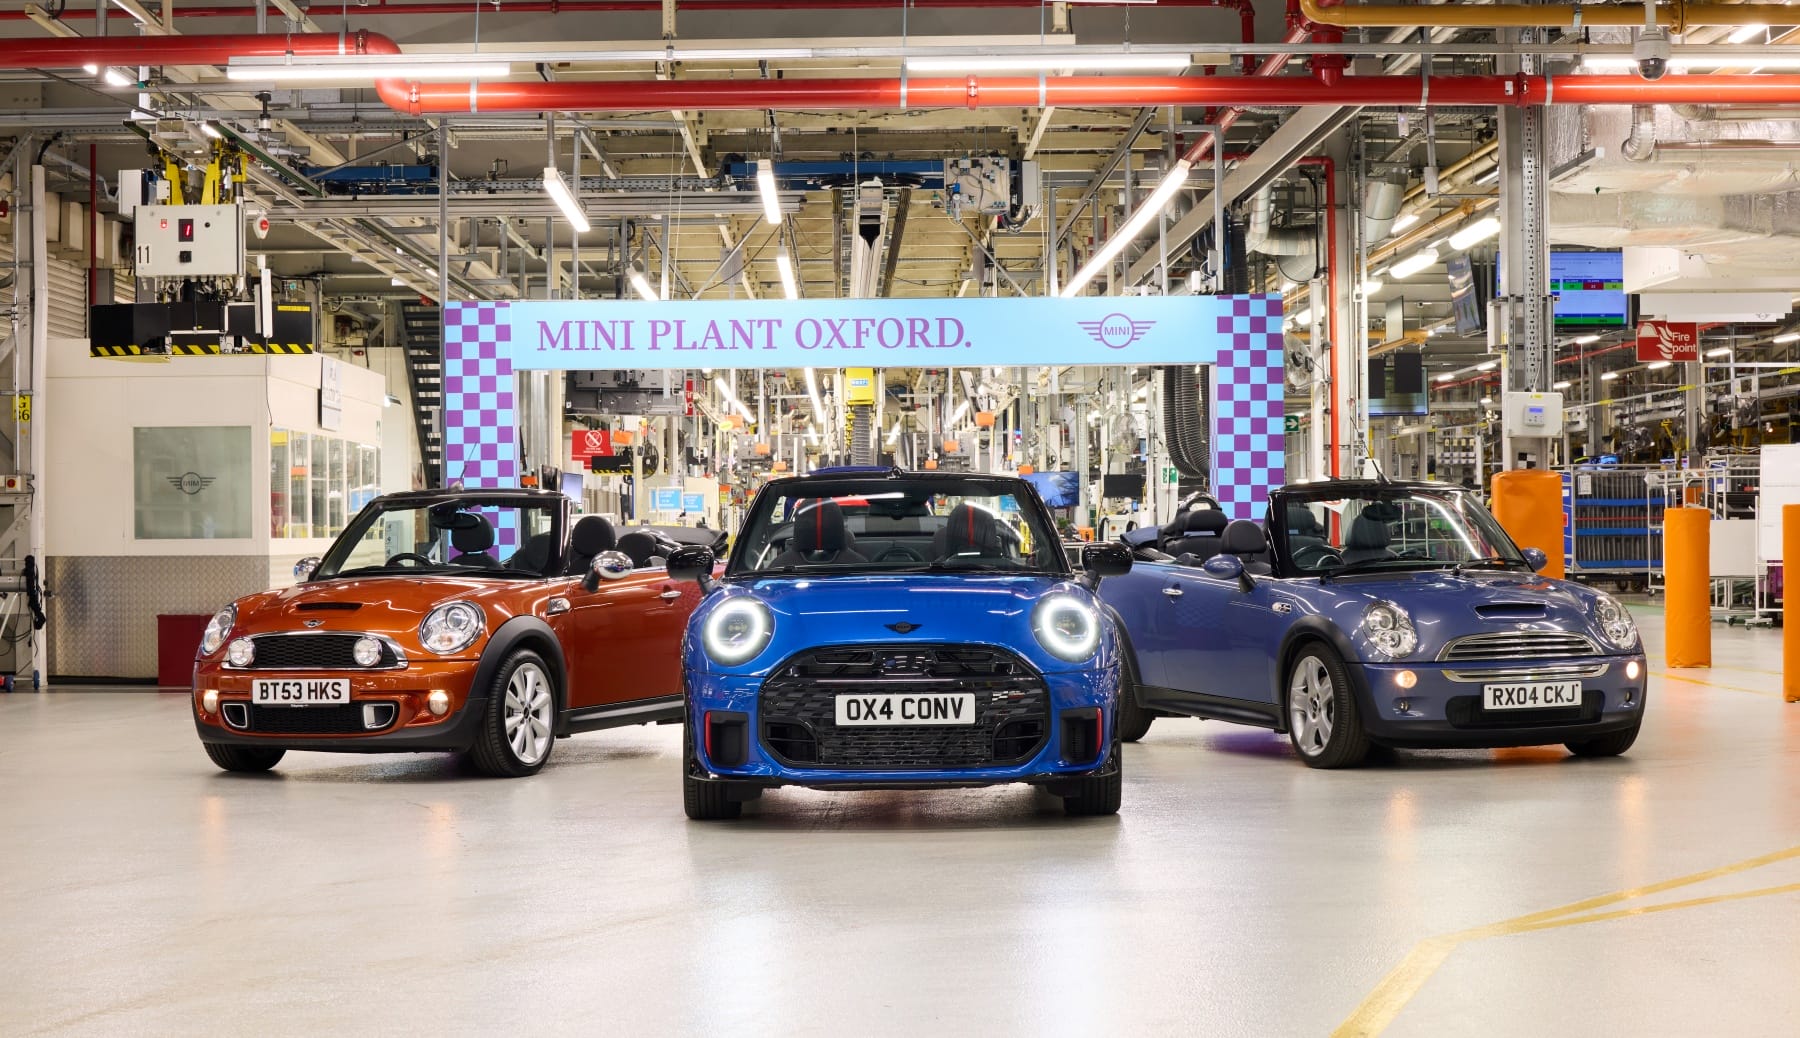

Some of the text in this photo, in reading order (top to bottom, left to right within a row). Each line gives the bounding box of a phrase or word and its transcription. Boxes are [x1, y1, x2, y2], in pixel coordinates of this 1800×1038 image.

[137, 245, 150, 264] 11
[537, 317, 972, 351] MINI PLANT OXFORD.
[1104, 326, 1130, 336] MINI
[1672, 332, 1690, 342] Fire
[1672, 343, 1696, 354] point
[259, 682, 342, 700] BT53 HKS
[1492, 684, 1576, 706] RX04 CKJ
[846, 697, 964, 721] OX4 CONV
